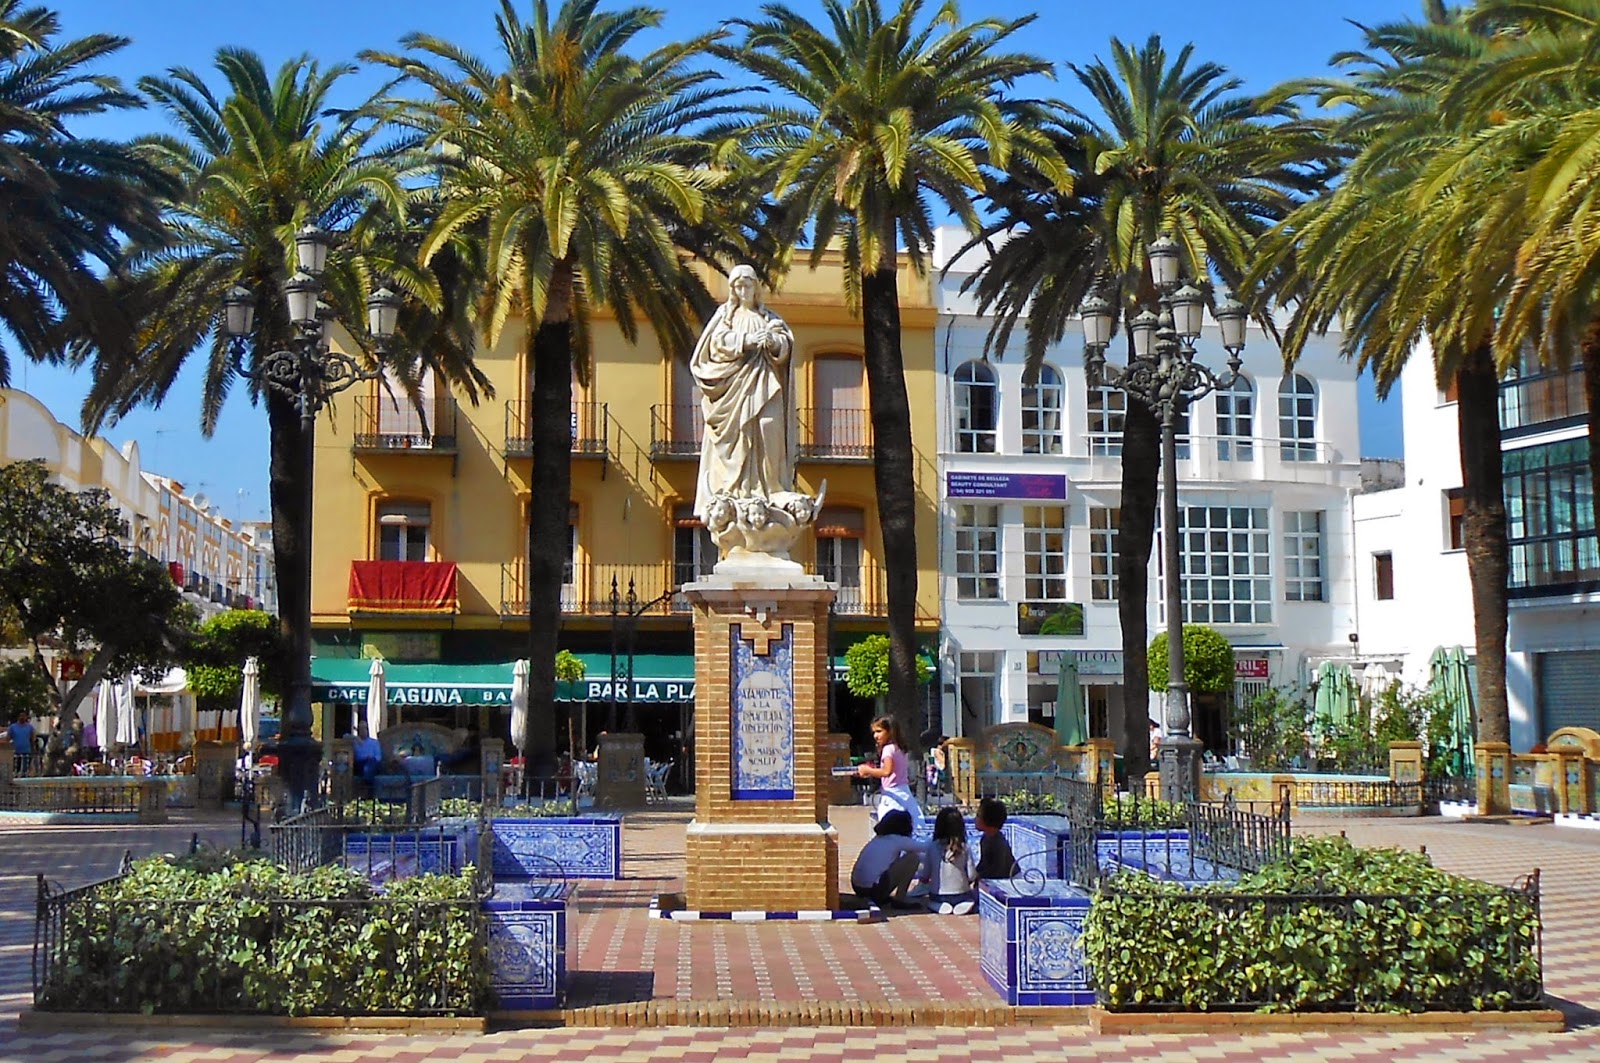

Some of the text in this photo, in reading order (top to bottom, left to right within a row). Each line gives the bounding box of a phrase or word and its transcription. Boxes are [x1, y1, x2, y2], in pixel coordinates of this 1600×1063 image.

[1045, 652, 1062, 662] LA
[328, 688, 366, 700] CAFE
[385, 688, 463, 703] LAGUNA
[588, 682, 628, 698] BAR
[635, 683, 659, 698] LA
[742, 688, 781, 699] AYAMONTE
[759, 700, 770, 708] LA
